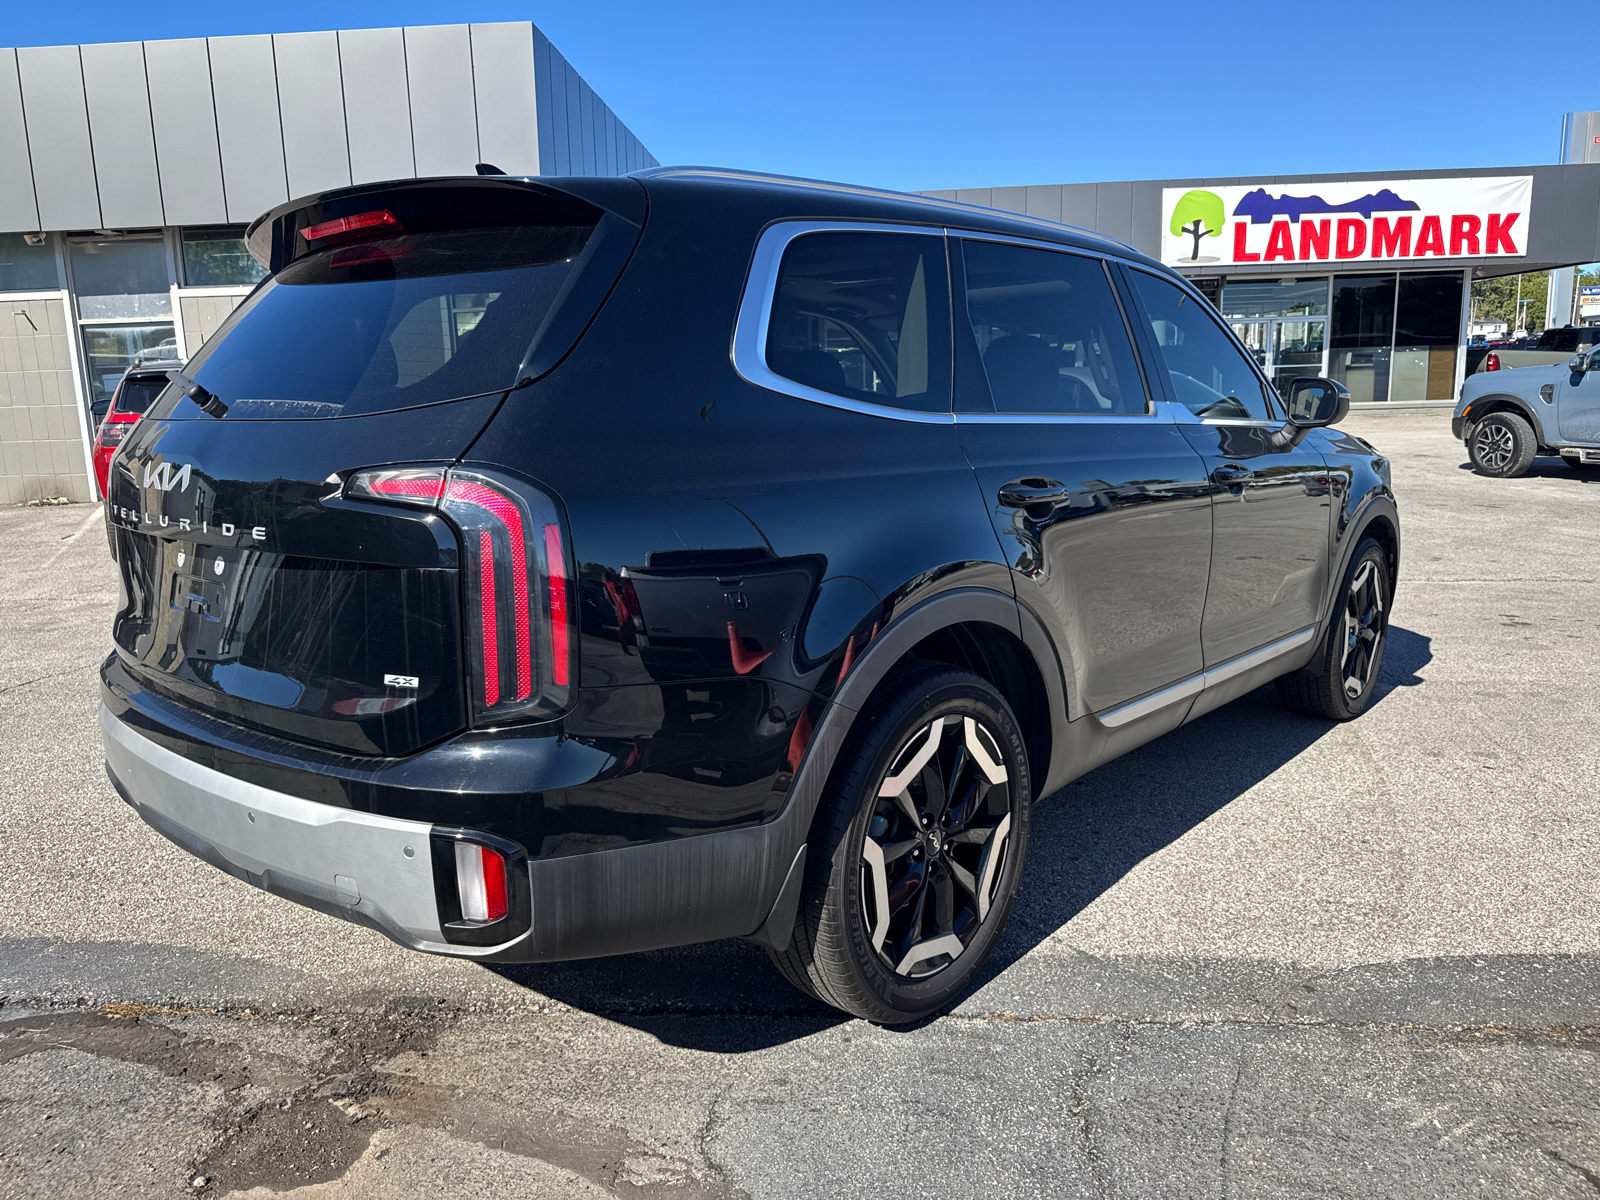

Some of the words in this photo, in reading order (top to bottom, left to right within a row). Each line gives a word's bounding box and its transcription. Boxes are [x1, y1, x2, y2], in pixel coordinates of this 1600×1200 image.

[1233, 213, 1521, 262] LANDMARK
[143, 461, 192, 493] KIA
[112, 505, 267, 541] TELLURIDE
[1010, 733, 1029, 822] MICHELIN
[849, 874, 876, 977] MICHELIN
